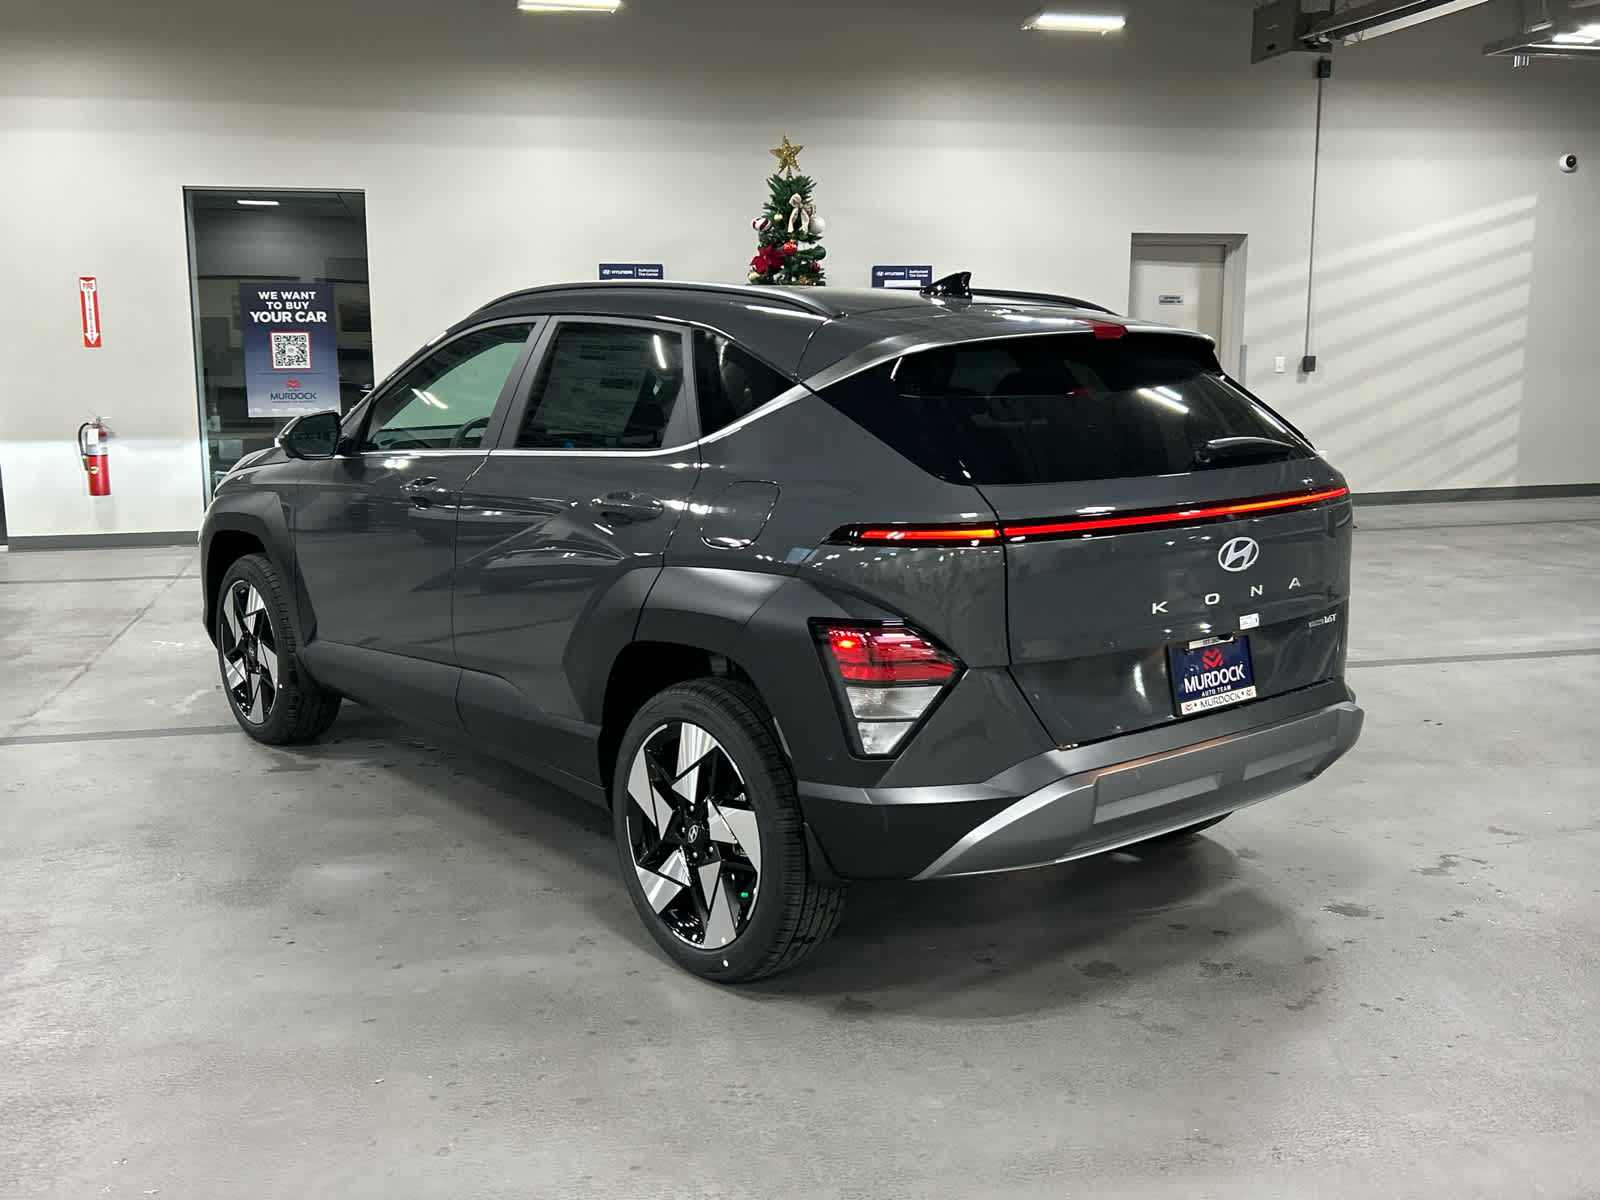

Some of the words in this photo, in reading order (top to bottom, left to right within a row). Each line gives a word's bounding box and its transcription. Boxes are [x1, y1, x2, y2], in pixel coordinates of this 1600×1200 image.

[257, 291, 278, 300] WE
[280, 291, 317, 300] WANT
[266, 301, 282, 310] TO
[285, 301, 310, 310] BUY
[249, 311, 292, 323] YOUR
[295, 311, 328, 323] CAR
[270, 392, 318, 401] MURDOCK
[1183, 663, 1246, 694] MURDOCK
[1201, 687, 1216, 697] AUTO
[1217, 684, 1232, 693] TEAM
[1200, 692, 1241, 709] MURDOCK
